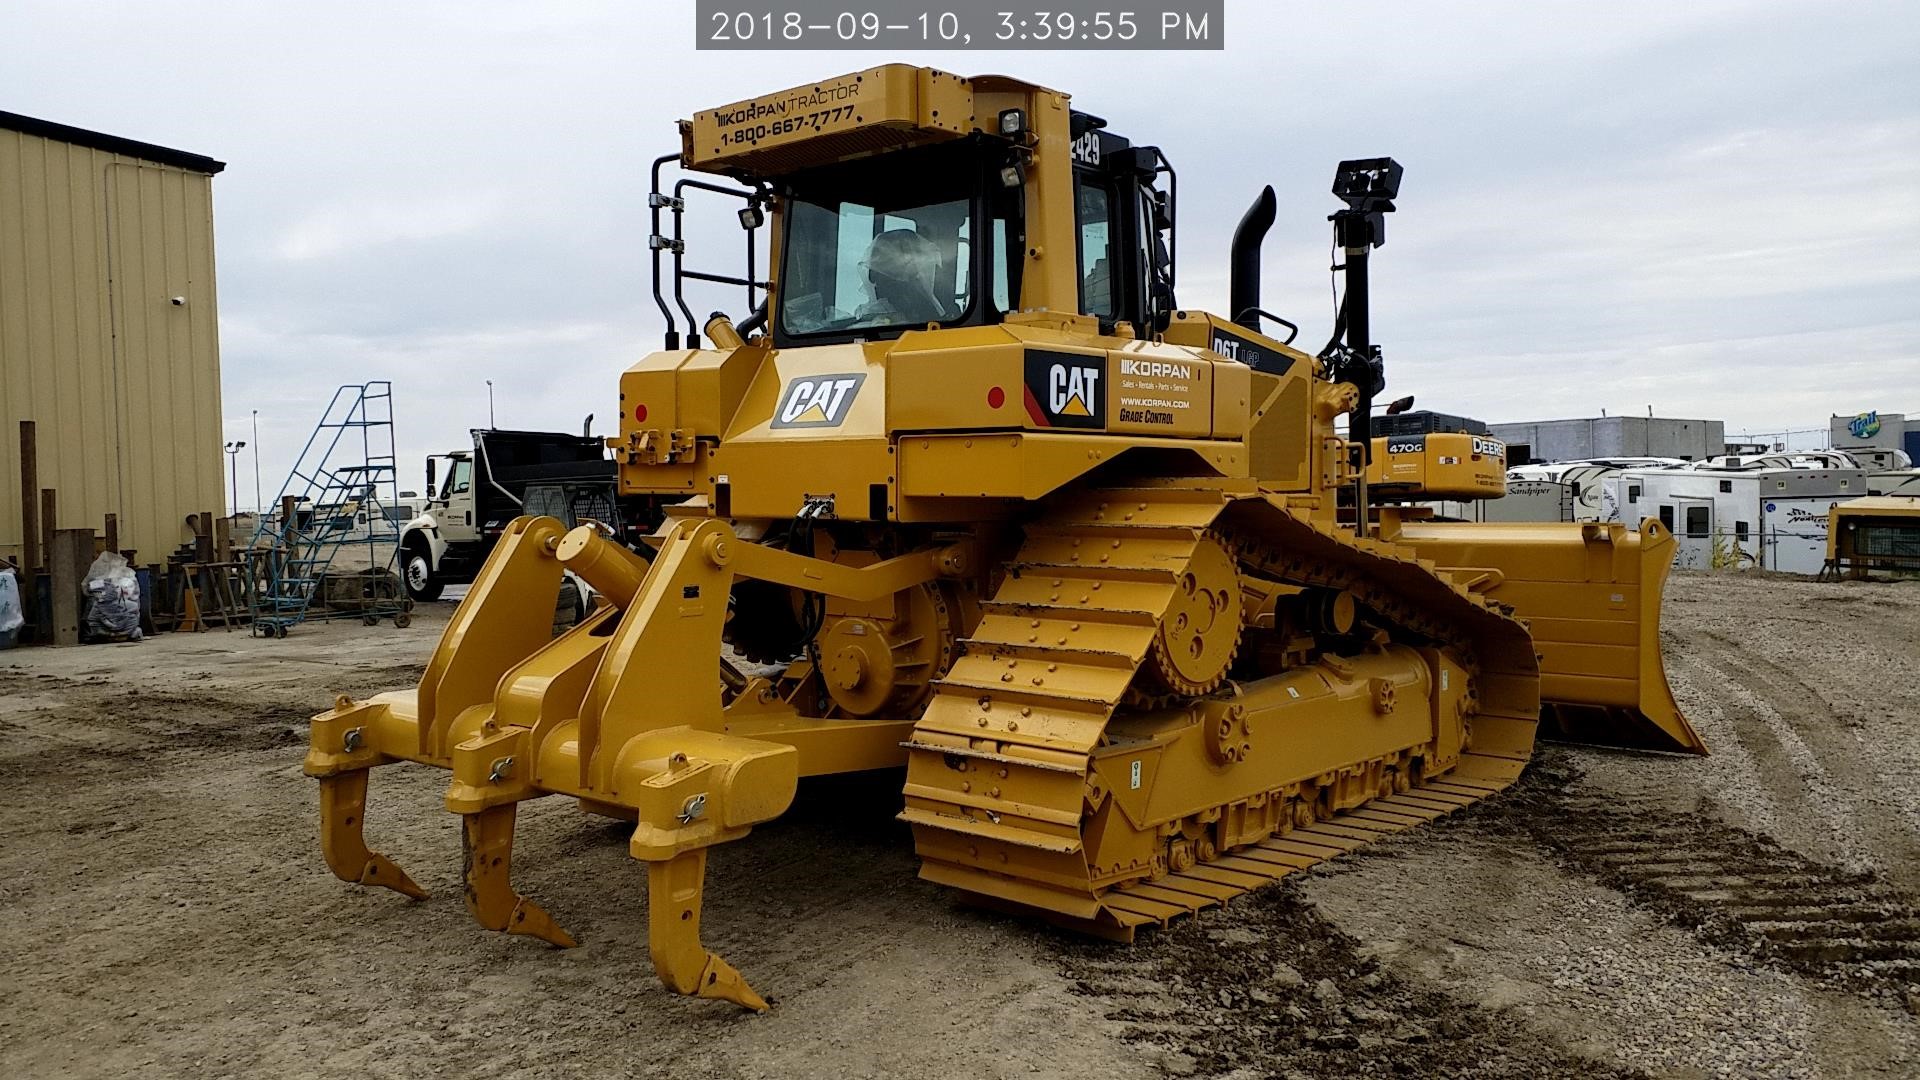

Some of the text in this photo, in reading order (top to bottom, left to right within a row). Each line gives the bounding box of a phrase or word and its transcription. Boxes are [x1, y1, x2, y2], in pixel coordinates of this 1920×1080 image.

[718, 83, 860, 128] KORPAN TRACTOR
[721, 105, 855, 147] 1-800-667-7777
[1213, 337, 1240, 361] D6T
[1120, 359, 1191, 379] KORPAN
[781, 379, 857, 423] CAT
[1049, 363, 1099, 417] CAT
[1120, 397, 1190, 409] WWW.KORPAN.COM
[1389, 443, 1423, 453] 470G
[1472, 437, 1504, 457] DEERE
[1508, 486, 1551, 496] Sandpiper
